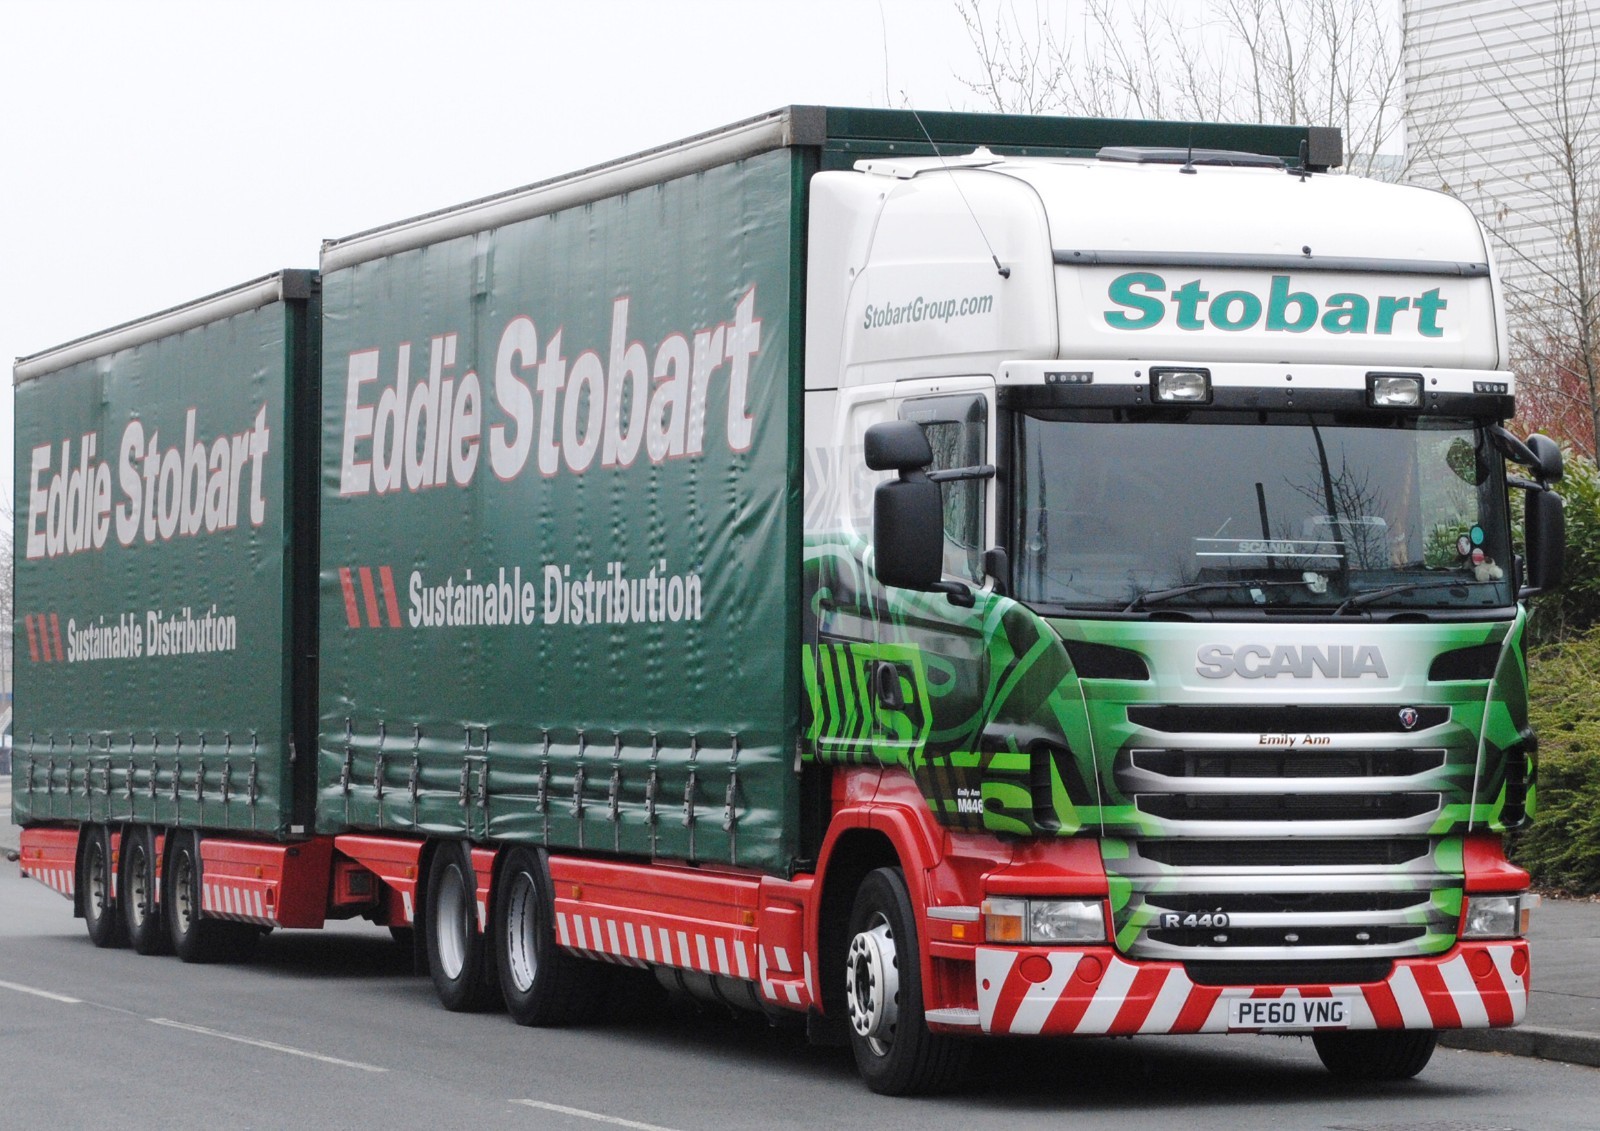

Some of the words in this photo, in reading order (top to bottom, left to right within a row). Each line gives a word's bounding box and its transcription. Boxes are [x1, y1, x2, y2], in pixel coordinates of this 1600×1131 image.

[863, 294, 994, 330] StobartGroup.com
[1103, 270, 1448, 338] Stobart
[340, 331, 483, 496] Eddie
[488, 283, 762, 482] Stobart
[26, 431, 112, 560] Eddie
[115, 402, 270, 547] Stobart
[1238, 542, 1295, 554] SCANIA
[408, 567, 535, 628] Sustainable
[544, 559, 702, 626] Distribution
[67, 612, 143, 663] Sustainable
[146, 604, 237, 657] Distribution
[1196, 643, 1389, 680] SCANIA
[1258, 734, 1296, 747] Emily
[1302, 733, 1331, 745] Ann
[1165, 914, 1180, 928] R
[1183, 913, 1227, 928] 440
[1238, 1002, 1296, 1023] PE60
[1303, 1001, 1343, 1022] VNG
